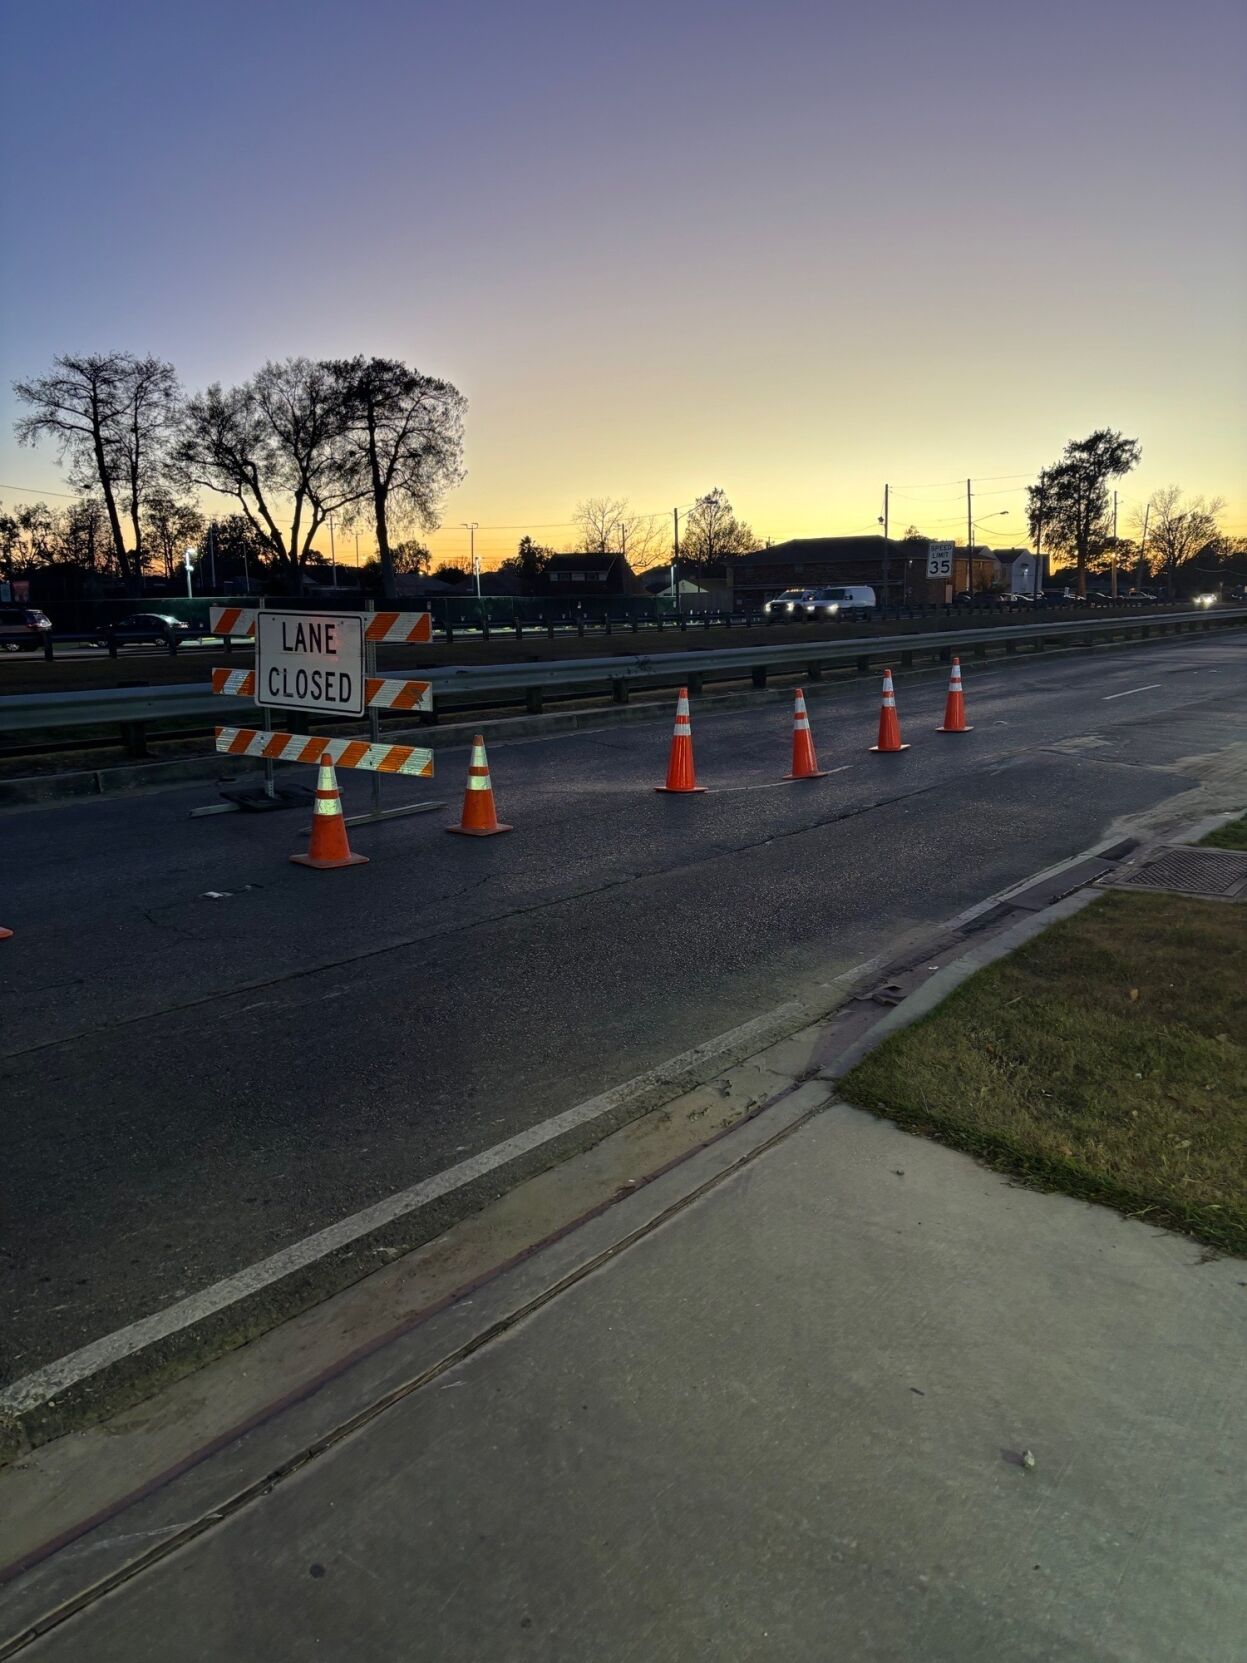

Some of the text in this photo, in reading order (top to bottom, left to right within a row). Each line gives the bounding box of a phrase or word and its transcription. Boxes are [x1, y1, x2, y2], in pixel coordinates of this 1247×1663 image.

[929, 560, 950, 574] 35
[931, 551, 949, 559] LIMIT
[282, 621, 337, 655] LANE
[268, 666, 352, 703] CLOSED
